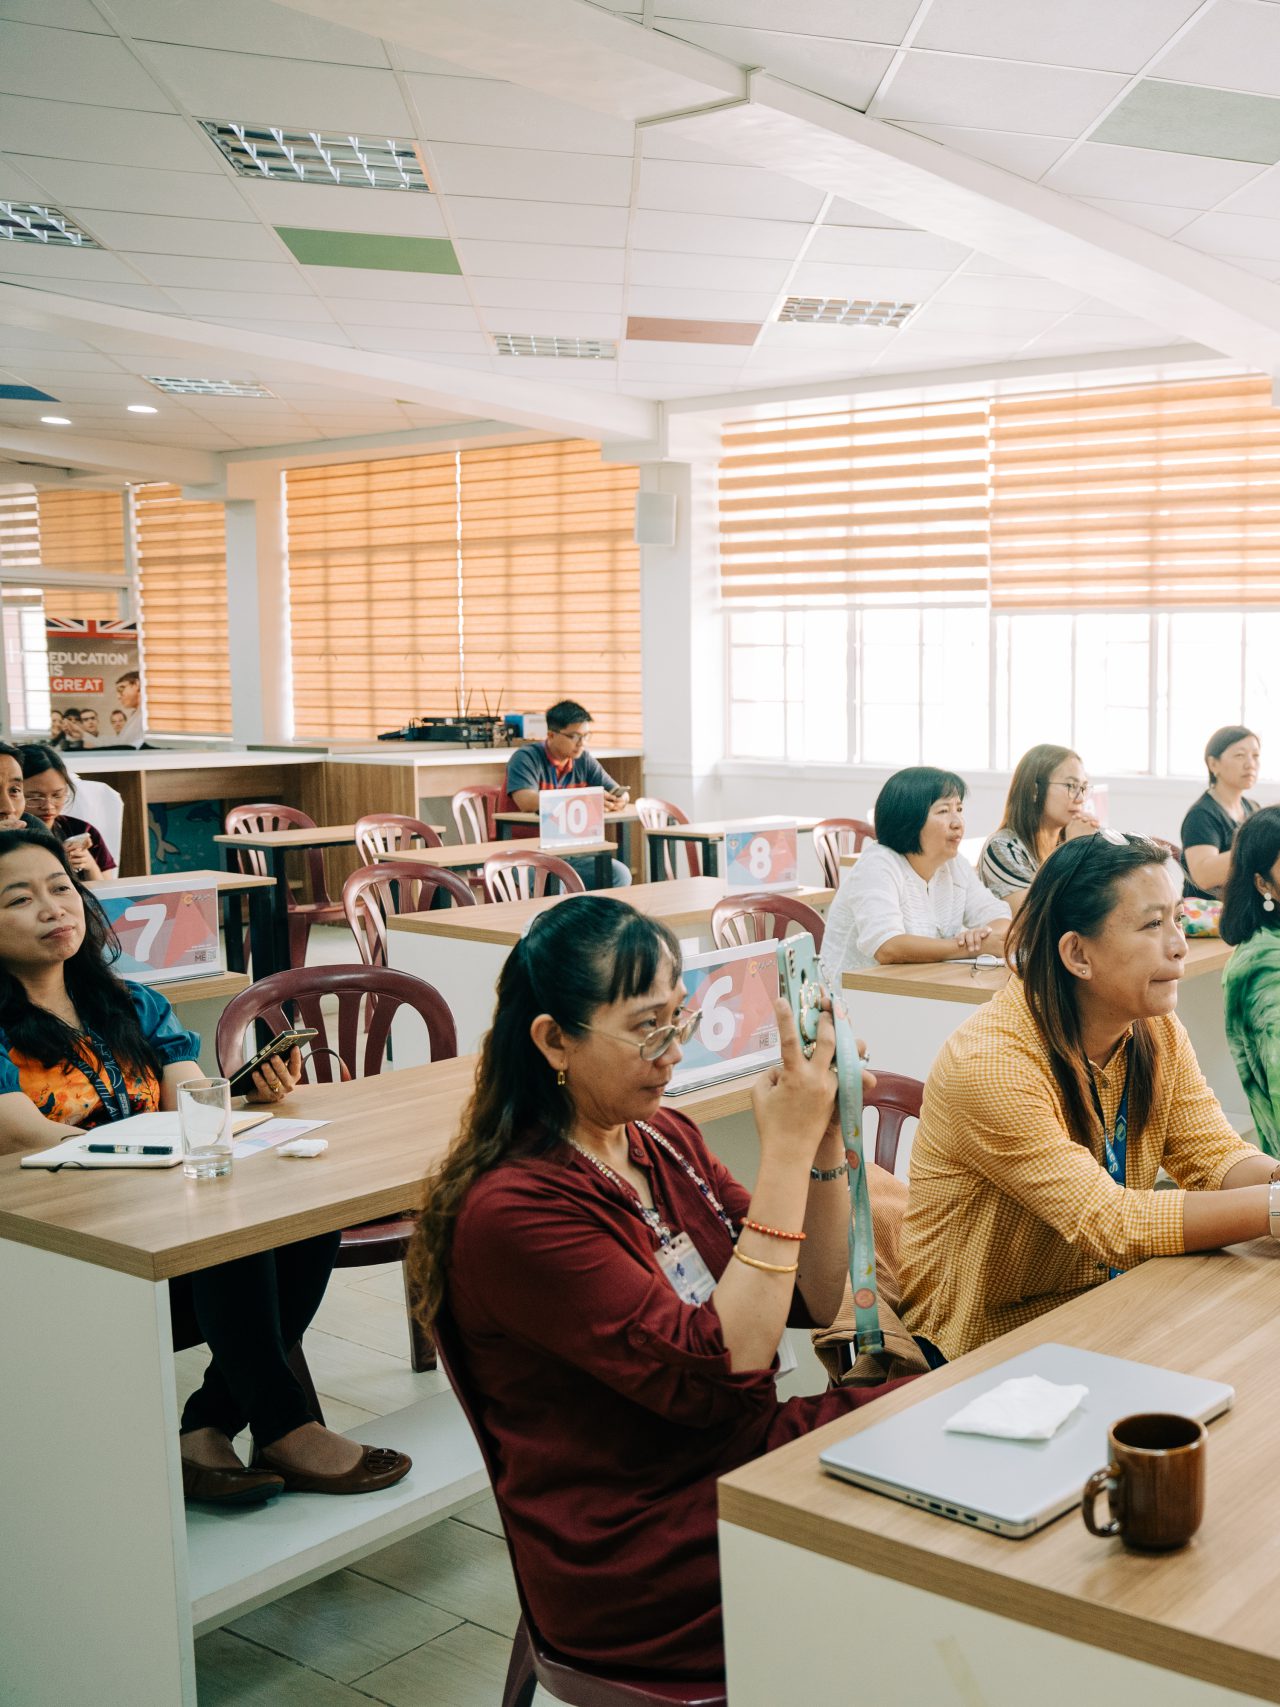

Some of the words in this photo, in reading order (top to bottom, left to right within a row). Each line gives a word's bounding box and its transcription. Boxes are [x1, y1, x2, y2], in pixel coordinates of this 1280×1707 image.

[48, 652, 128, 665] EDUCATION
[50, 665, 63, 676] IS
[53, 679, 102, 691] GREAT
[553, 799, 588, 835] 10
[749, 836, 772, 879] 8
[124, 903, 167, 962] 7
[699, 975, 736, 1052] 6
